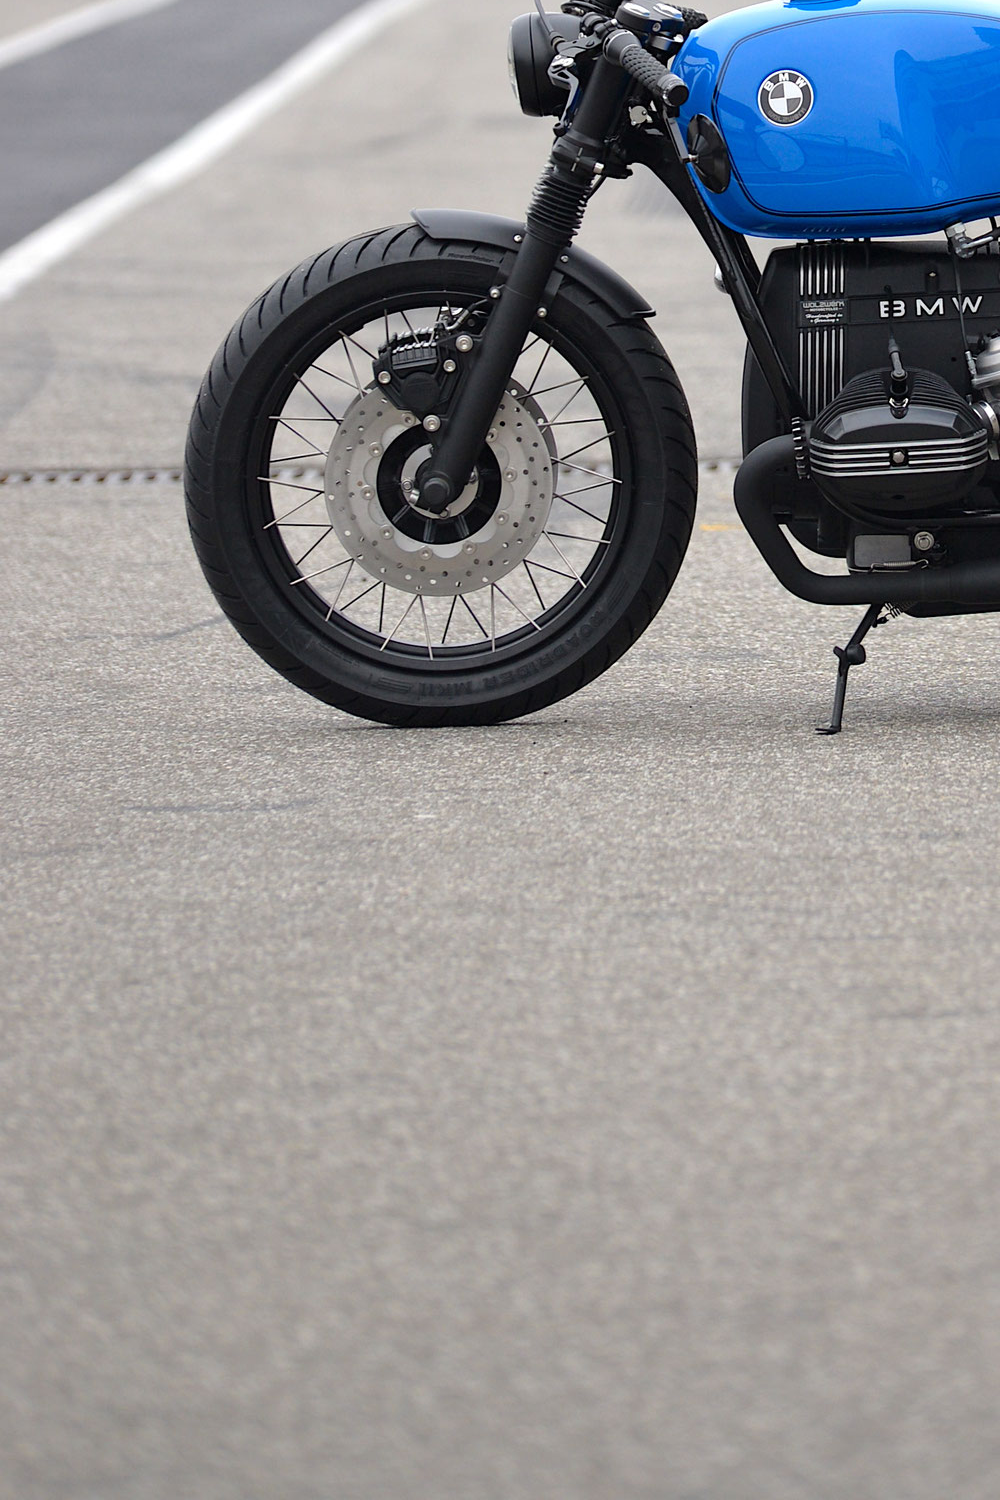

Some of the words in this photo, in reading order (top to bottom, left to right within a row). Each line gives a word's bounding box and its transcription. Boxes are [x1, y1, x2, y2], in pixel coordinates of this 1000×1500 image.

[763, 72, 807, 92] BMW
[879, 295, 983, 318] BMW
[482, 609, 605, 690] ROADRIDER
